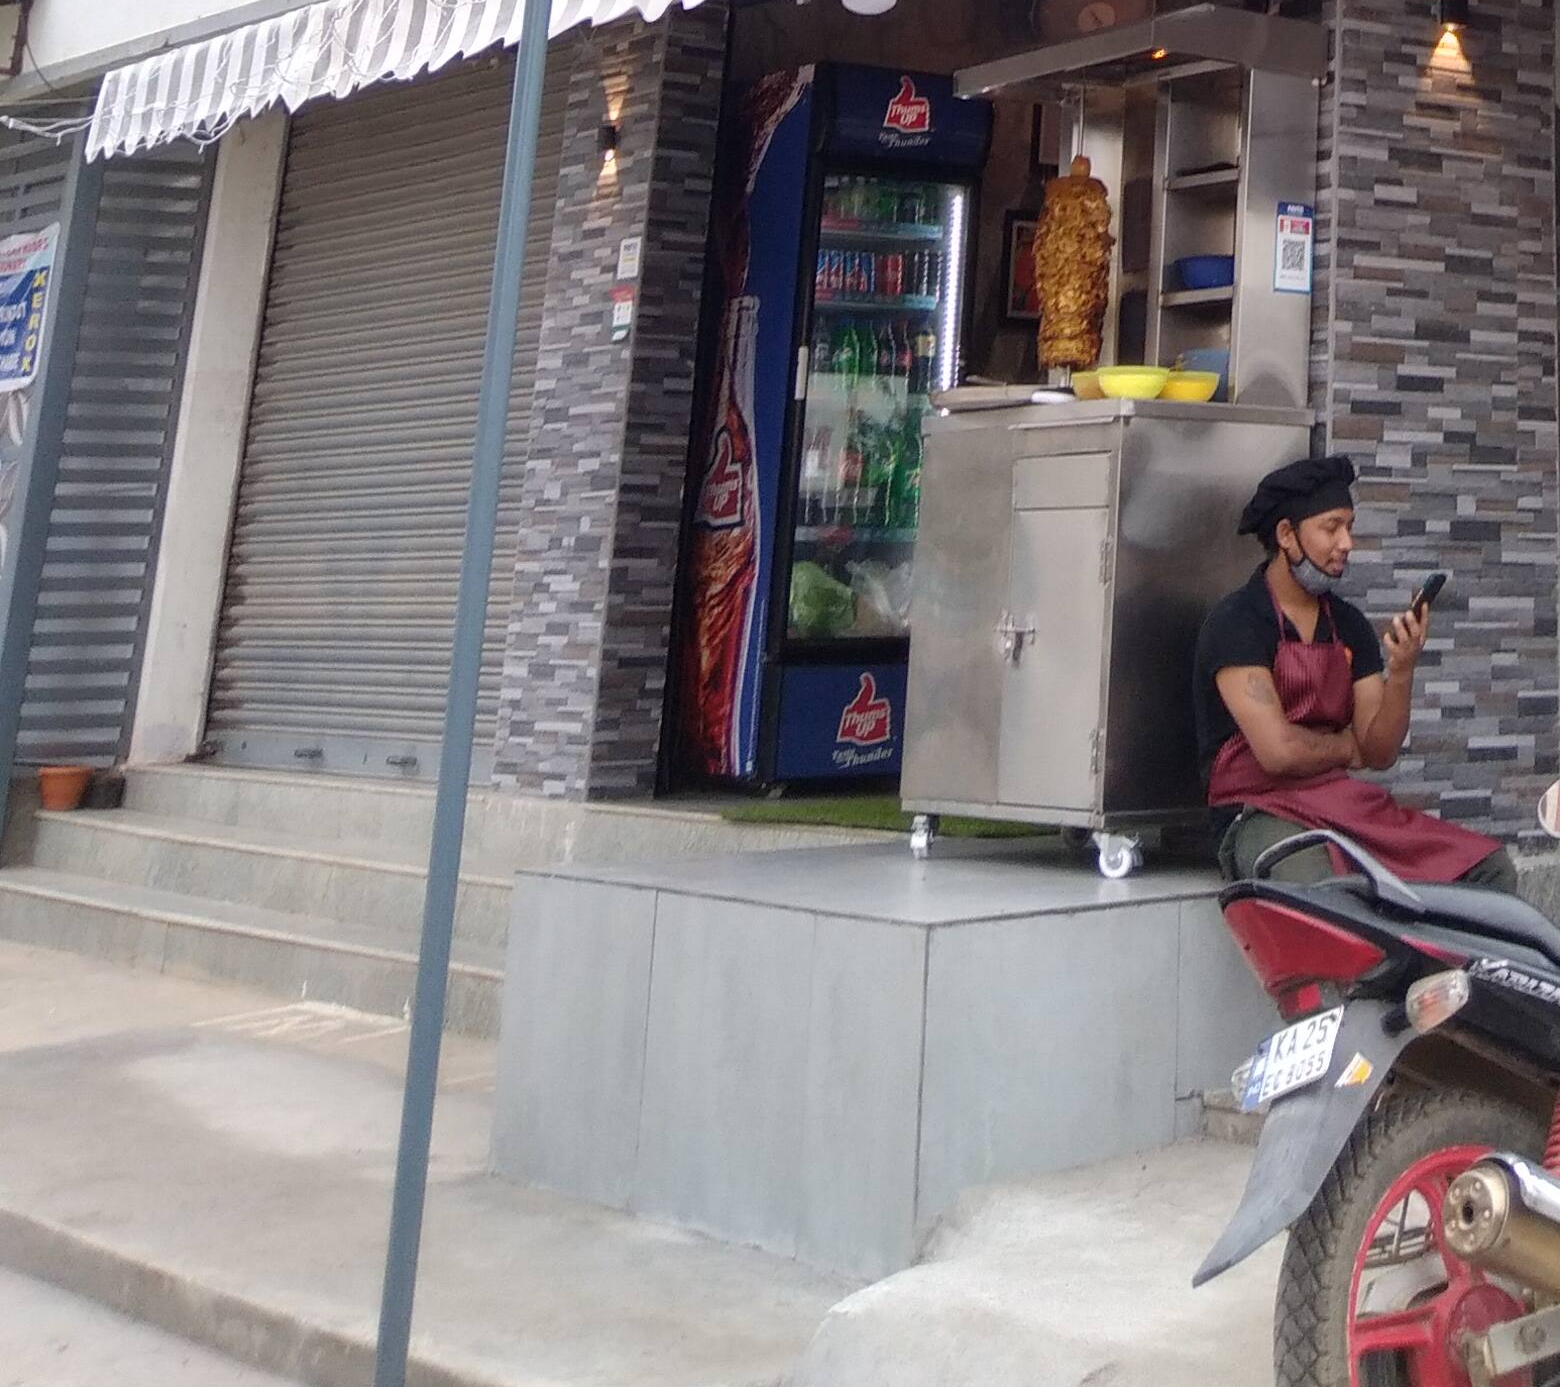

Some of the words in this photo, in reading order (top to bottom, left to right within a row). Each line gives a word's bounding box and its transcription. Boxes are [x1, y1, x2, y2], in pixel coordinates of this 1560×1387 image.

[22, 269, 48, 373] XEROX
[1273, 1027, 1298, 1064] KA
[1302, 1015, 1331, 1050] 25
